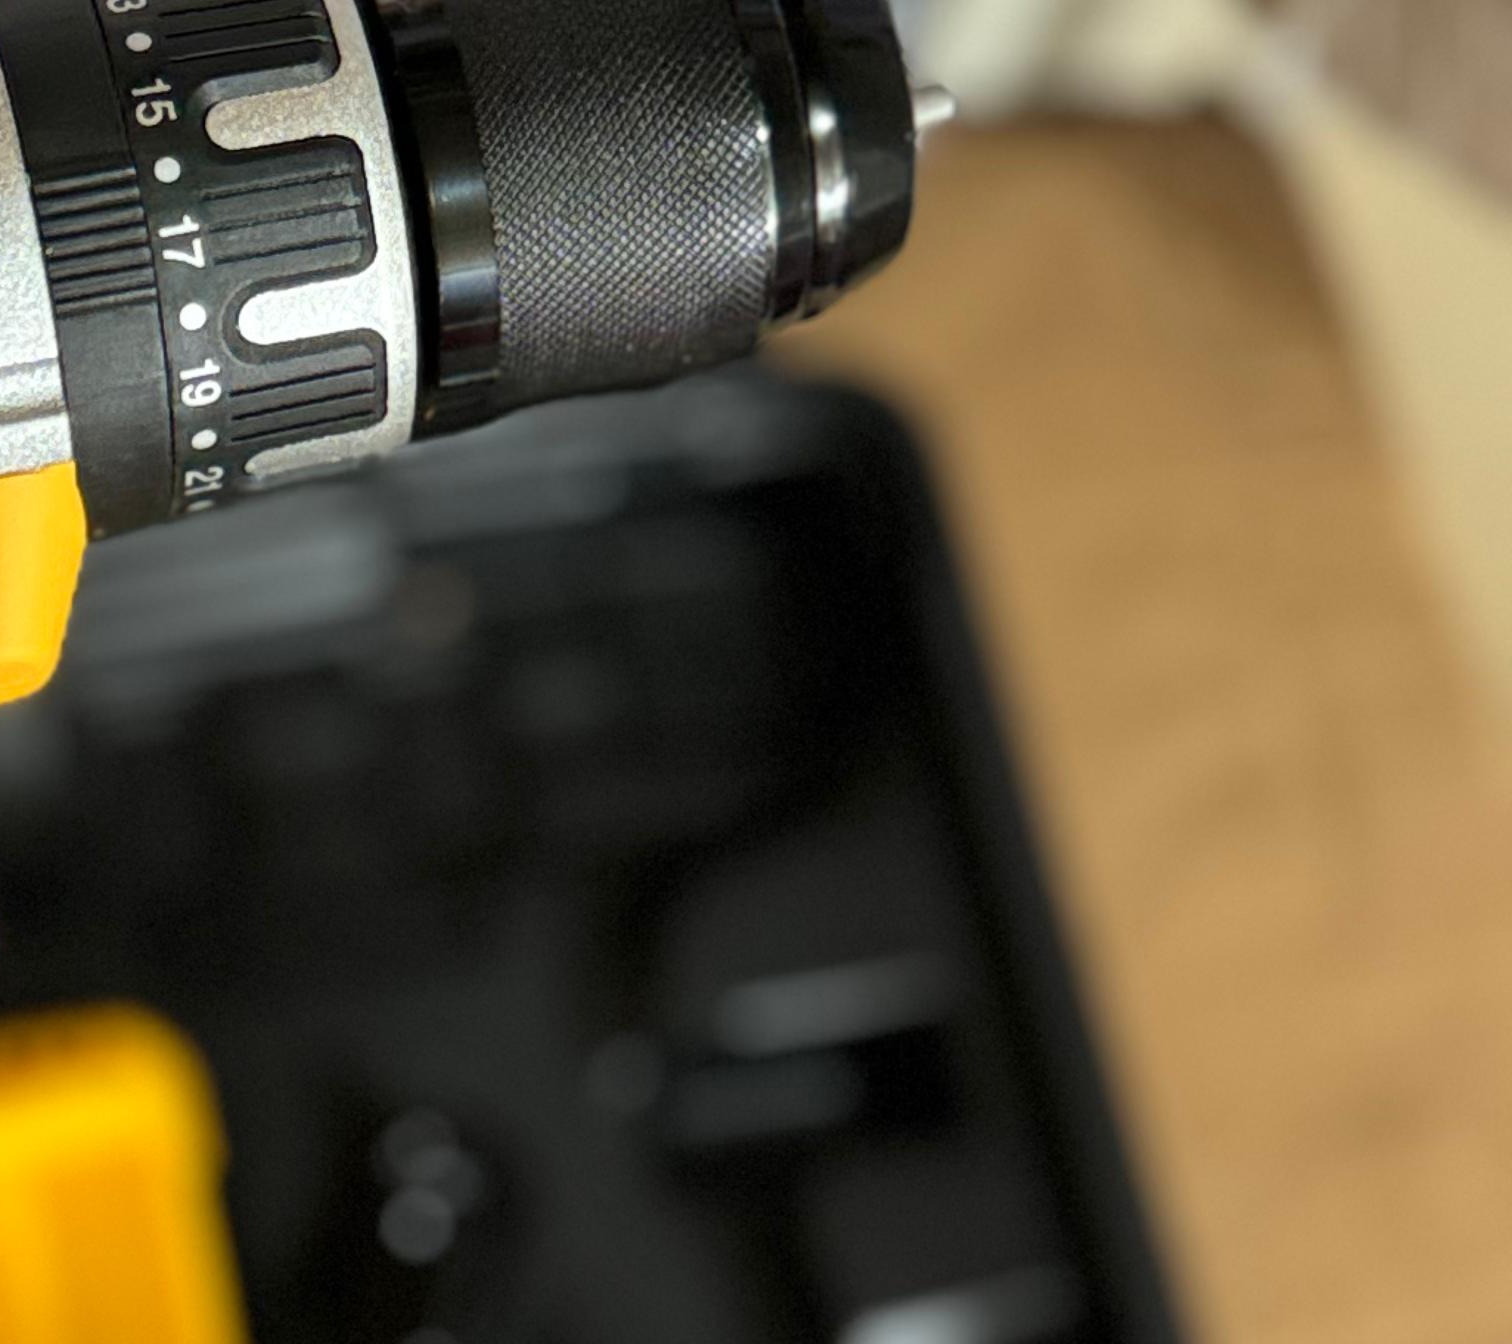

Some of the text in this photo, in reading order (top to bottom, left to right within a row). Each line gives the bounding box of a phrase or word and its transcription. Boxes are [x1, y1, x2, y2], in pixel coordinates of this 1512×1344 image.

[132, 78, 178, 127] 15
[158, 214, 205, 269] 17
[179, 358, 221, 408] 19
[186, 466, 224, 496] 21
